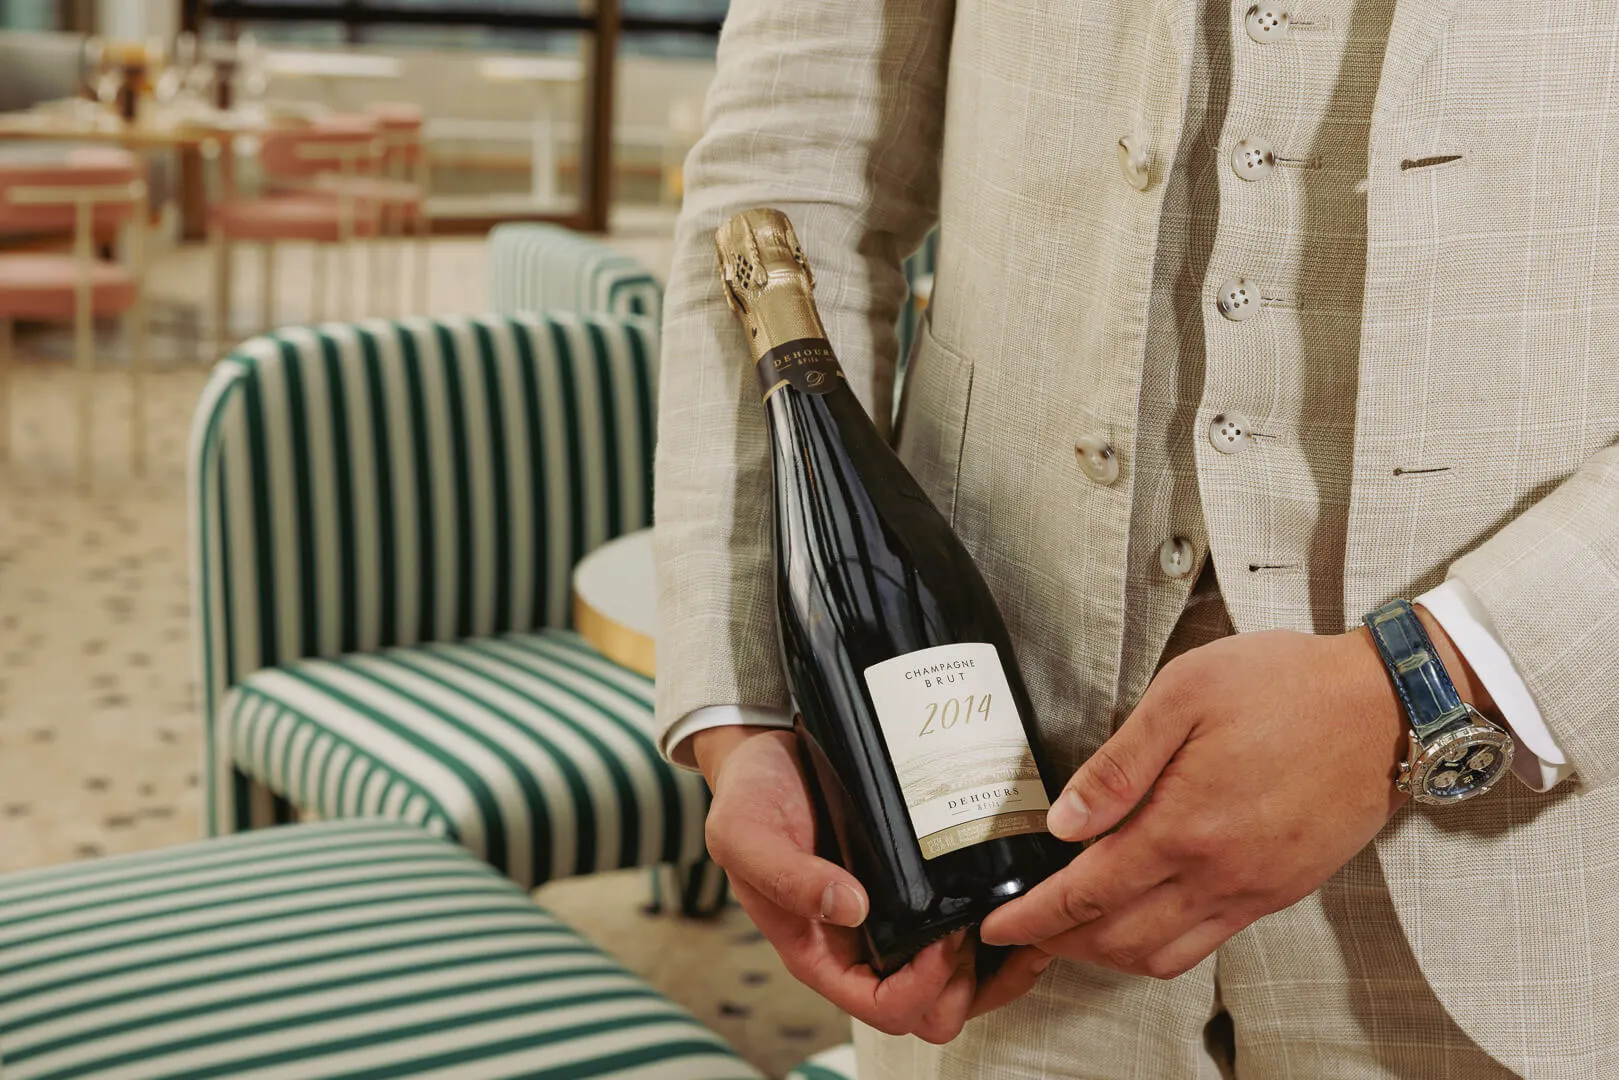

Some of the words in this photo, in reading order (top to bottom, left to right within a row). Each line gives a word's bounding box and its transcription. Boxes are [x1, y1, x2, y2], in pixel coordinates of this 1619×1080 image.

[905, 659, 976, 680] CHAMPAGNE
[925, 672, 966, 688] BRUT
[918, 693, 992, 737] 2014
[948, 787, 1019, 809] DEHOURS
